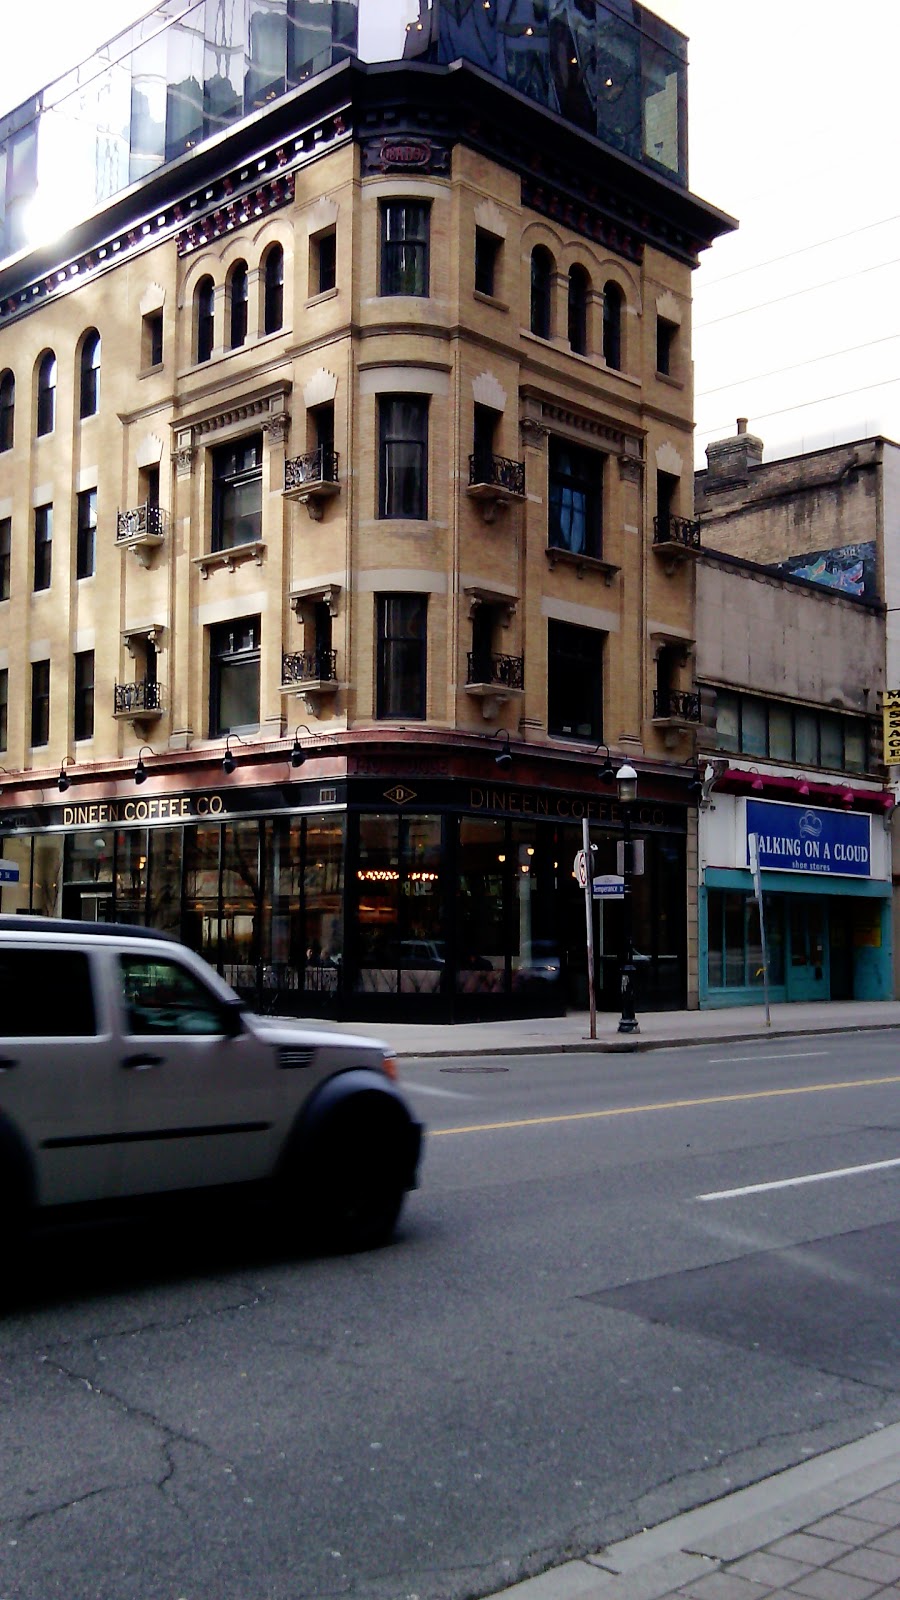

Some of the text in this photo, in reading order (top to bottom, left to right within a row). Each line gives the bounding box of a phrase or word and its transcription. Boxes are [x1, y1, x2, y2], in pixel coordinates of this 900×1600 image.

[887, 690, 900, 757] MASSAGE
[63, 795, 228, 825] DINEEN COFFEE CO.
[469, 786, 550, 816] DINEEN
[556, 799, 632, 822] COFFE
[757, 834, 869, 863] ALKING ON A CLOUD
[792, 860, 831, 872] shoe stores
[593, 885, 618, 893] Temperance
